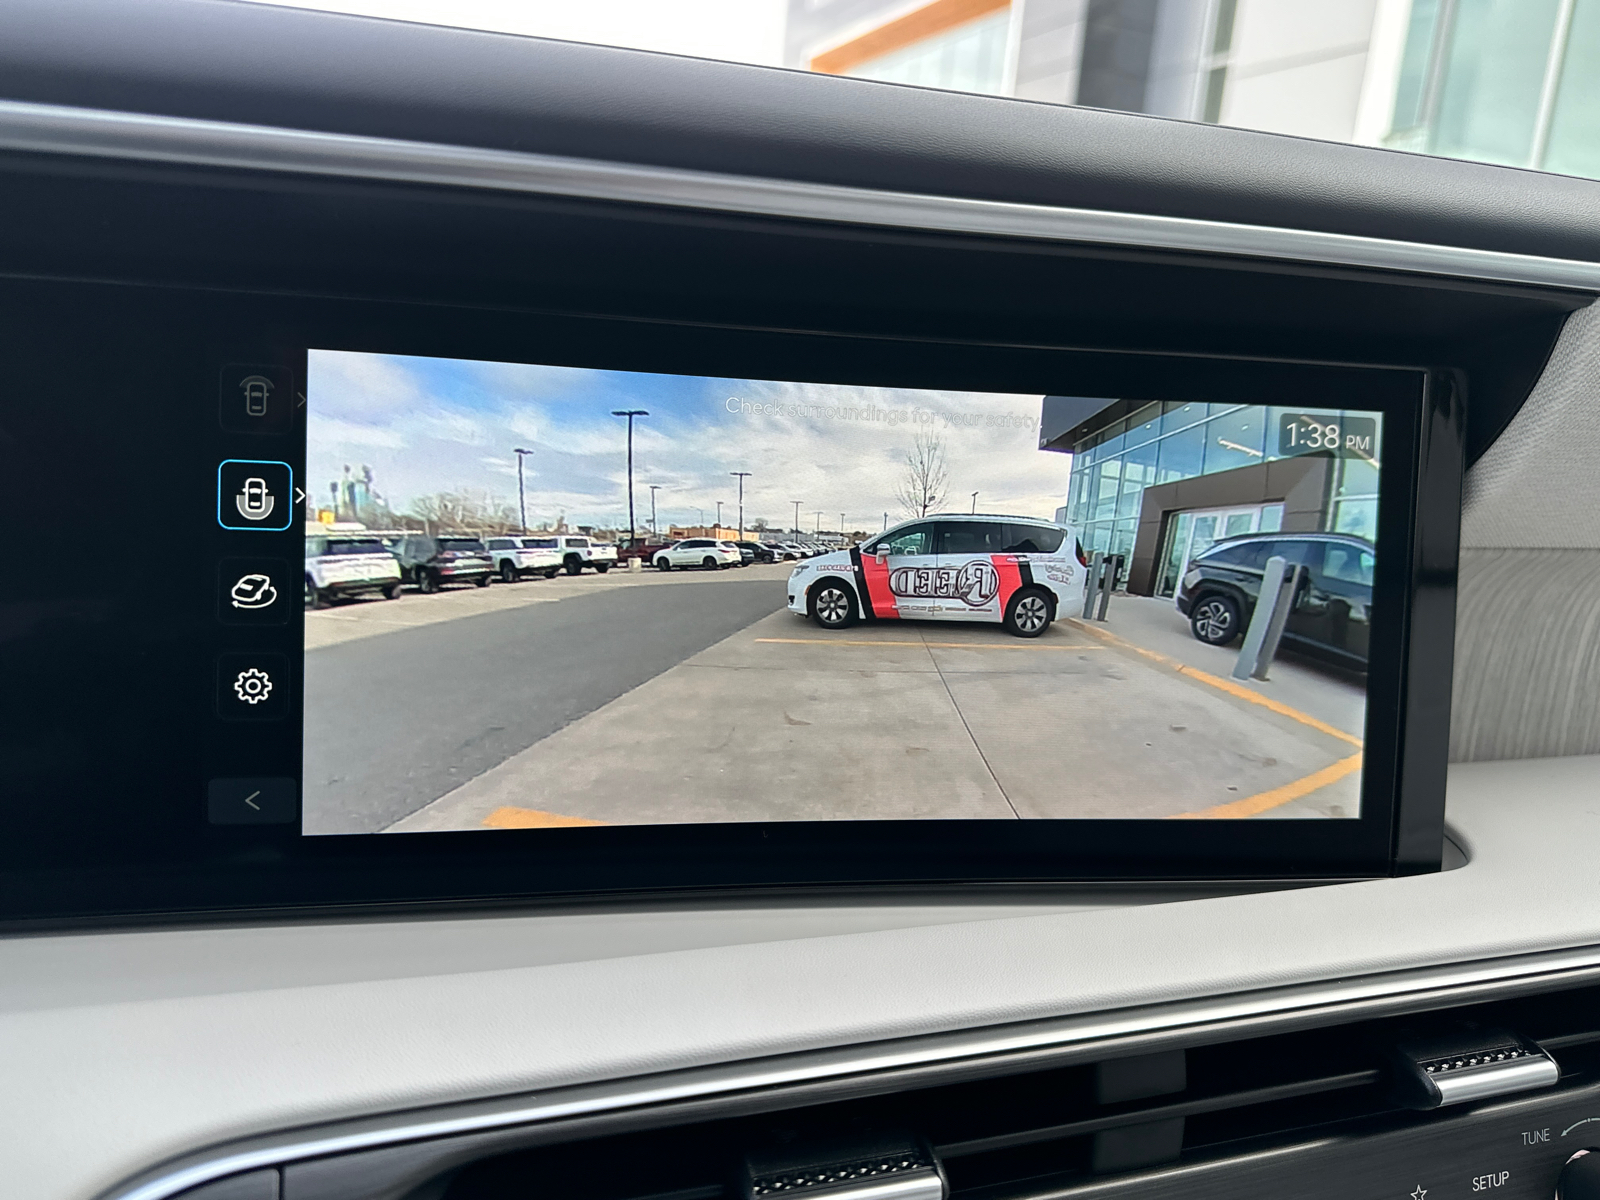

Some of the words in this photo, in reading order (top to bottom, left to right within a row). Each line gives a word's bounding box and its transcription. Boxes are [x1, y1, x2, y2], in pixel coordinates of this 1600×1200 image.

[725, 396, 784, 417] Check
[788, 403, 908, 426] surroundings
[911, 407, 938, 424] for
[942, 412, 983, 429] your
[1286, 422, 1340, 449] 1:38
[1345, 434, 1370, 450] PM
[1521, 1128, 1551, 1146] TUNE
[1472, 1170, 1510, 1192] SETUP
